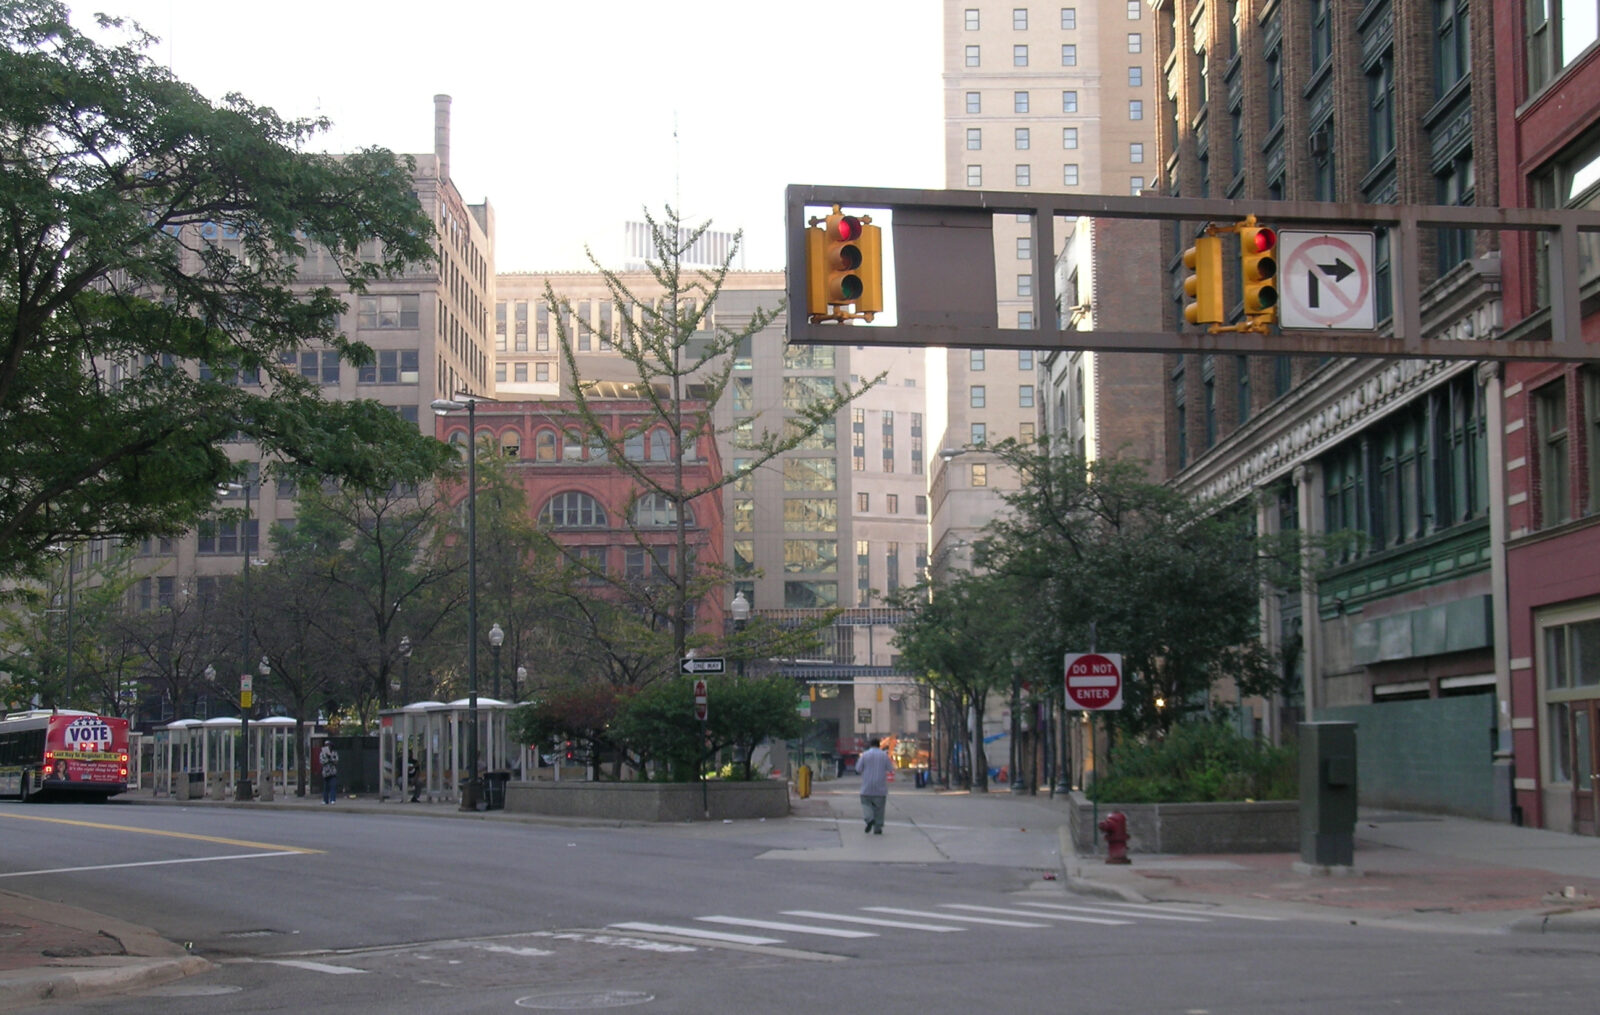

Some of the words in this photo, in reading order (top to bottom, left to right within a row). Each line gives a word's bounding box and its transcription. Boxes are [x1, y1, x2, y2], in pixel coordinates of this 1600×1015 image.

[1073, 664, 1087, 674] DO
[1092, 664, 1112, 674] NOT
[1077, 689, 1109, 699] ENTER
[70, 727, 108, 741] VOTE
